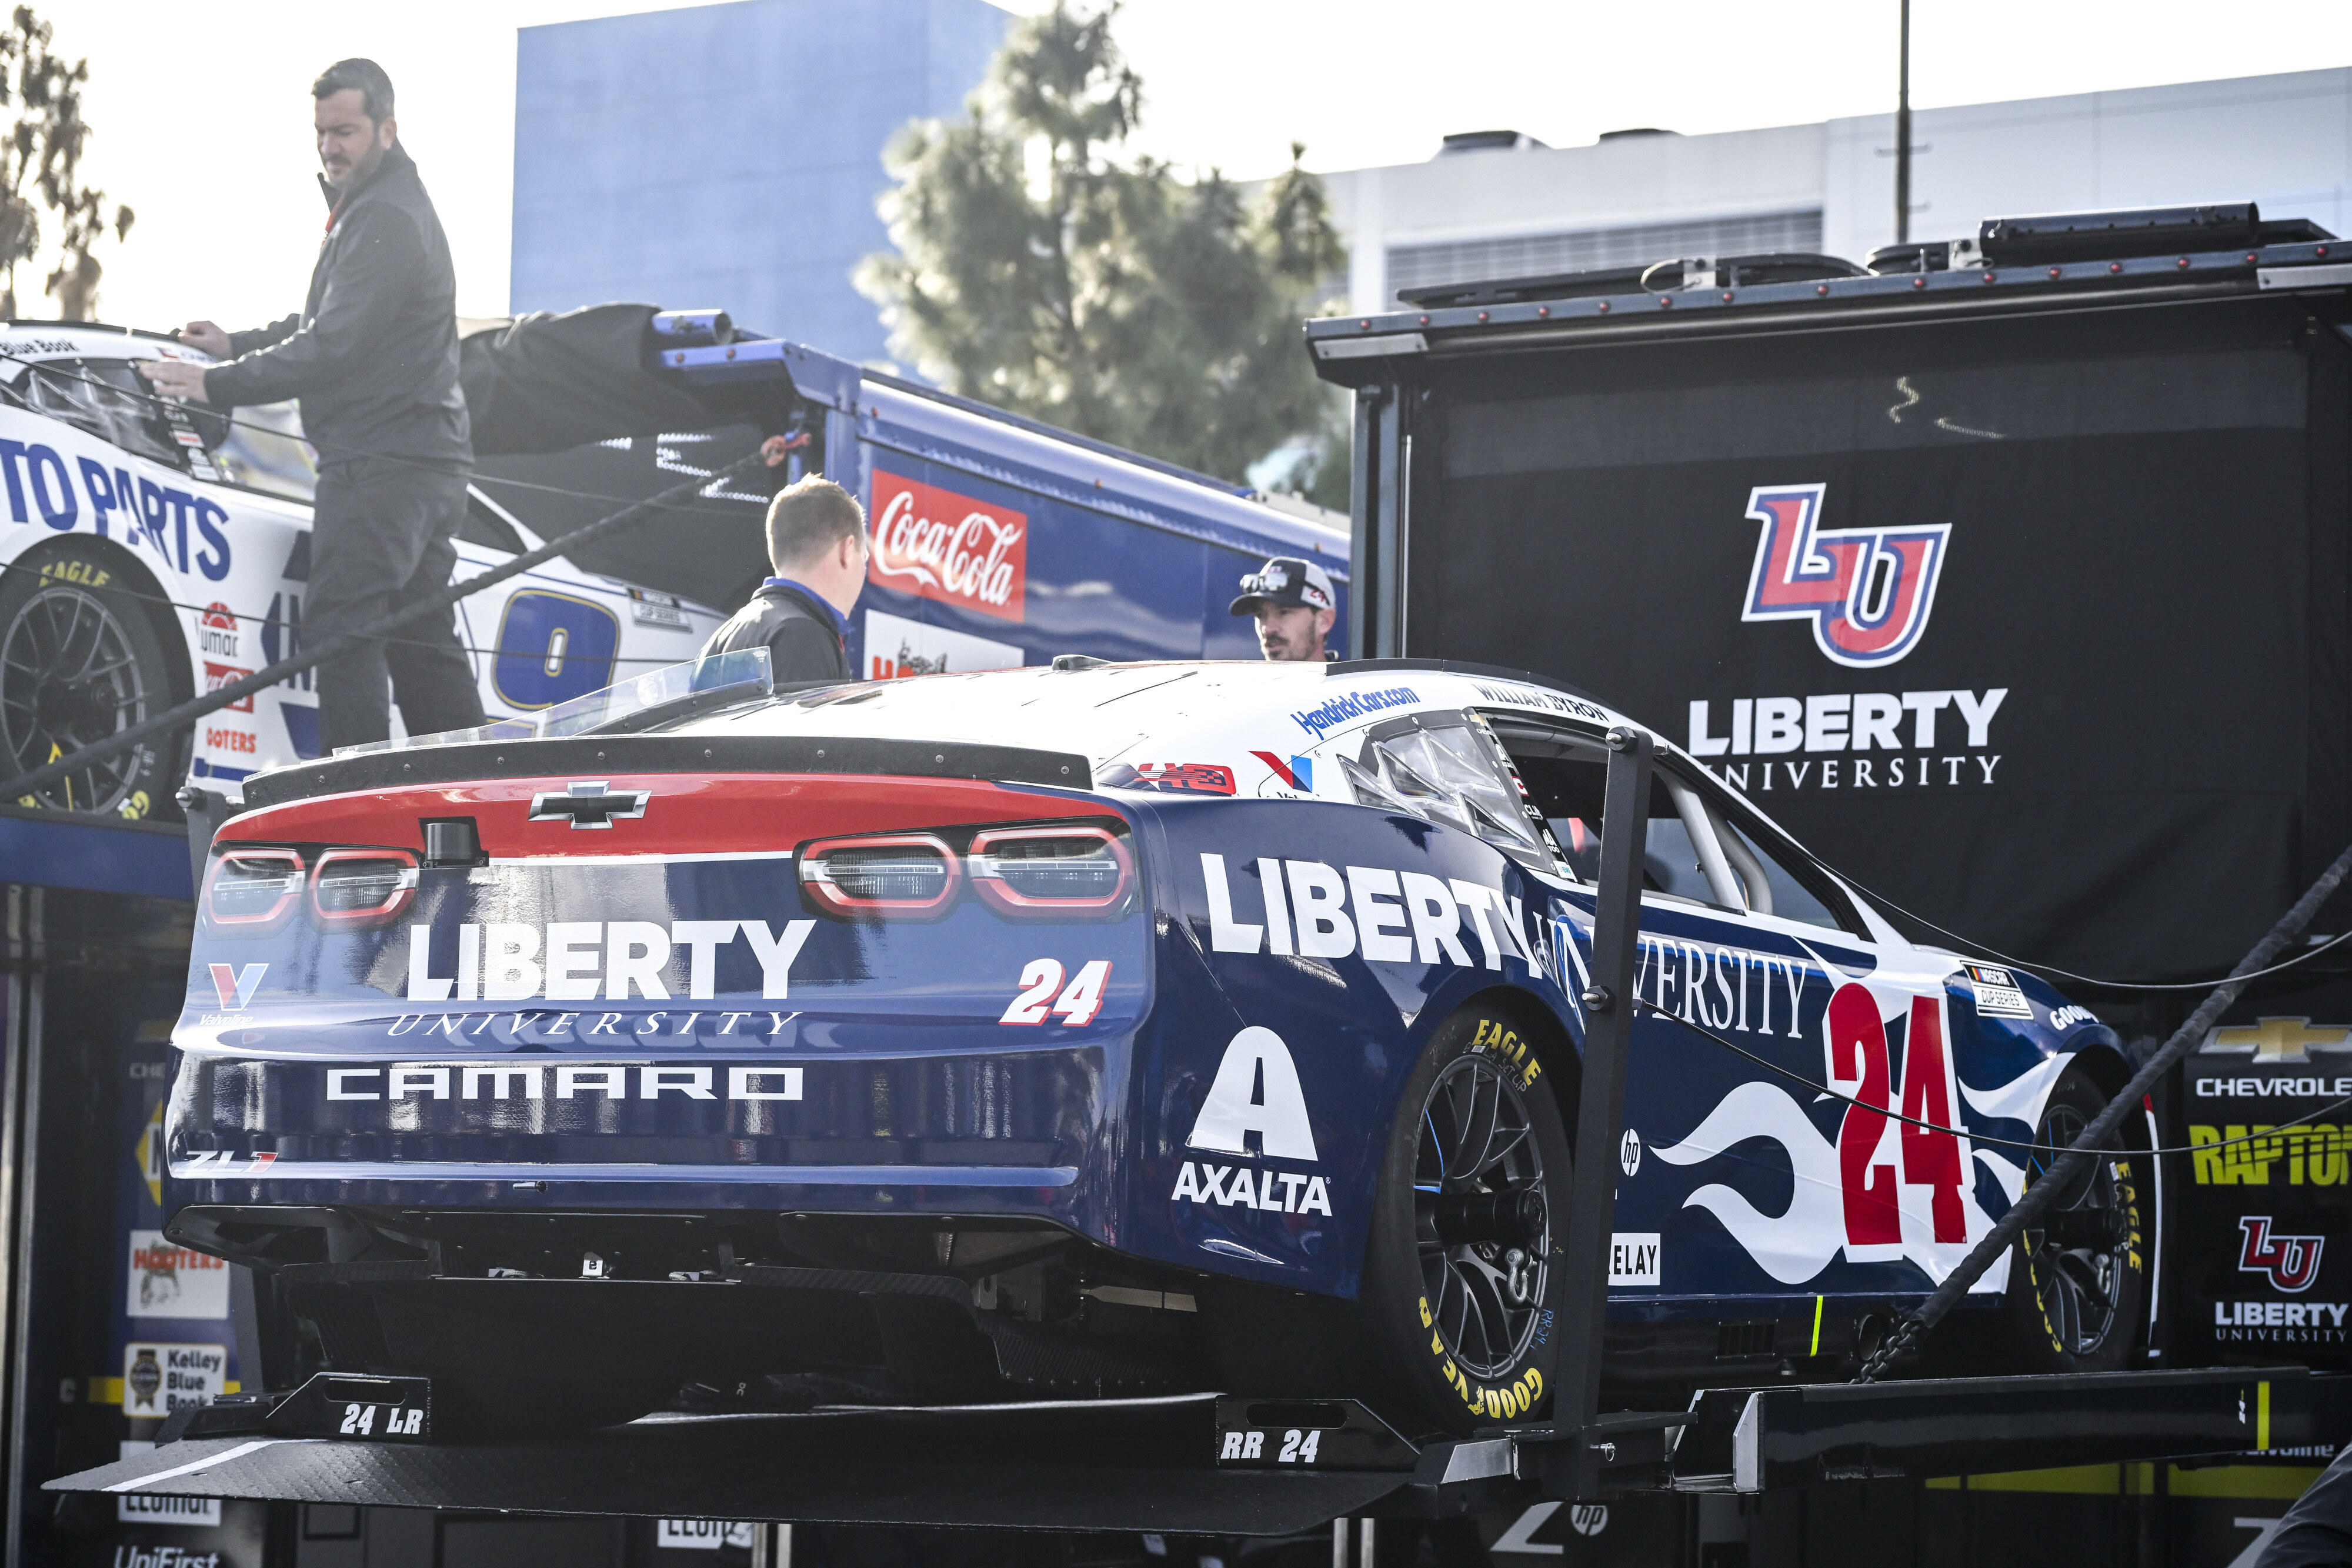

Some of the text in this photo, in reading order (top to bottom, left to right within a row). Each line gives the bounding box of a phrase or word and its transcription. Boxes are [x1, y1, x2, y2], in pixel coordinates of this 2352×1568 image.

[77, 456, 230, 581] PARTS
[875, 491, 1022, 606] Coca-Cola
[39, 561, 111, 588] EAGLE
[1741, 482, 1953, 669] LU
[201, 628, 238, 658] umar
[1290, 686, 1421, 741] HendrickCars.com
[1470, 683, 1610, 723] WILLIAM BYRON
[1688, 688, 2009, 756] LIBERTY
[207, 728, 257, 753] OOTERS
[1704, 755, 2001, 792] NIVERSITY
[1200, 852, 1543, 979] LIBERTY
[406, 919, 818, 1002] LIBERTY
[1979, 968, 2010, 987] NASCAR
[998, 958, 1113, 1028] 24
[1981, 989, 2020, 1007] CUP SERIES
[199, 1014, 253, 1026] Valvoline
[386, 1011, 803, 1037] UNIVERSITY
[1472, 1019, 1542, 1086] EAGLE
[326, 1066, 803, 1101] CAMARO
[1827, 982, 1967, 1246] 24
[176, 1150, 278, 1173] ZL1
[1622, 1129, 1640, 1176] hp
[1171, 1160, 1332, 1217] AXALTA
[2116, 1161, 2142, 1275] EAGLE
[1610, 1245, 1657, 1275] ELAY
[2238, 1215, 2326, 1293] LU
[2215, 1301, 2350, 1327] LIBERTY
[2215, 1328, 2347, 1343] UNIVERSITY
[167, 1350, 222, 1373] Kelley
[1419, 1296, 1543, 1419] GOODYEAR
[167, 1372, 205, 1391] Blue
[339, 1403, 423, 1435] 24 LR
[1220, 1429, 1321, 1463] RR 24
[114, 1545, 219, 1568] UniFirst
